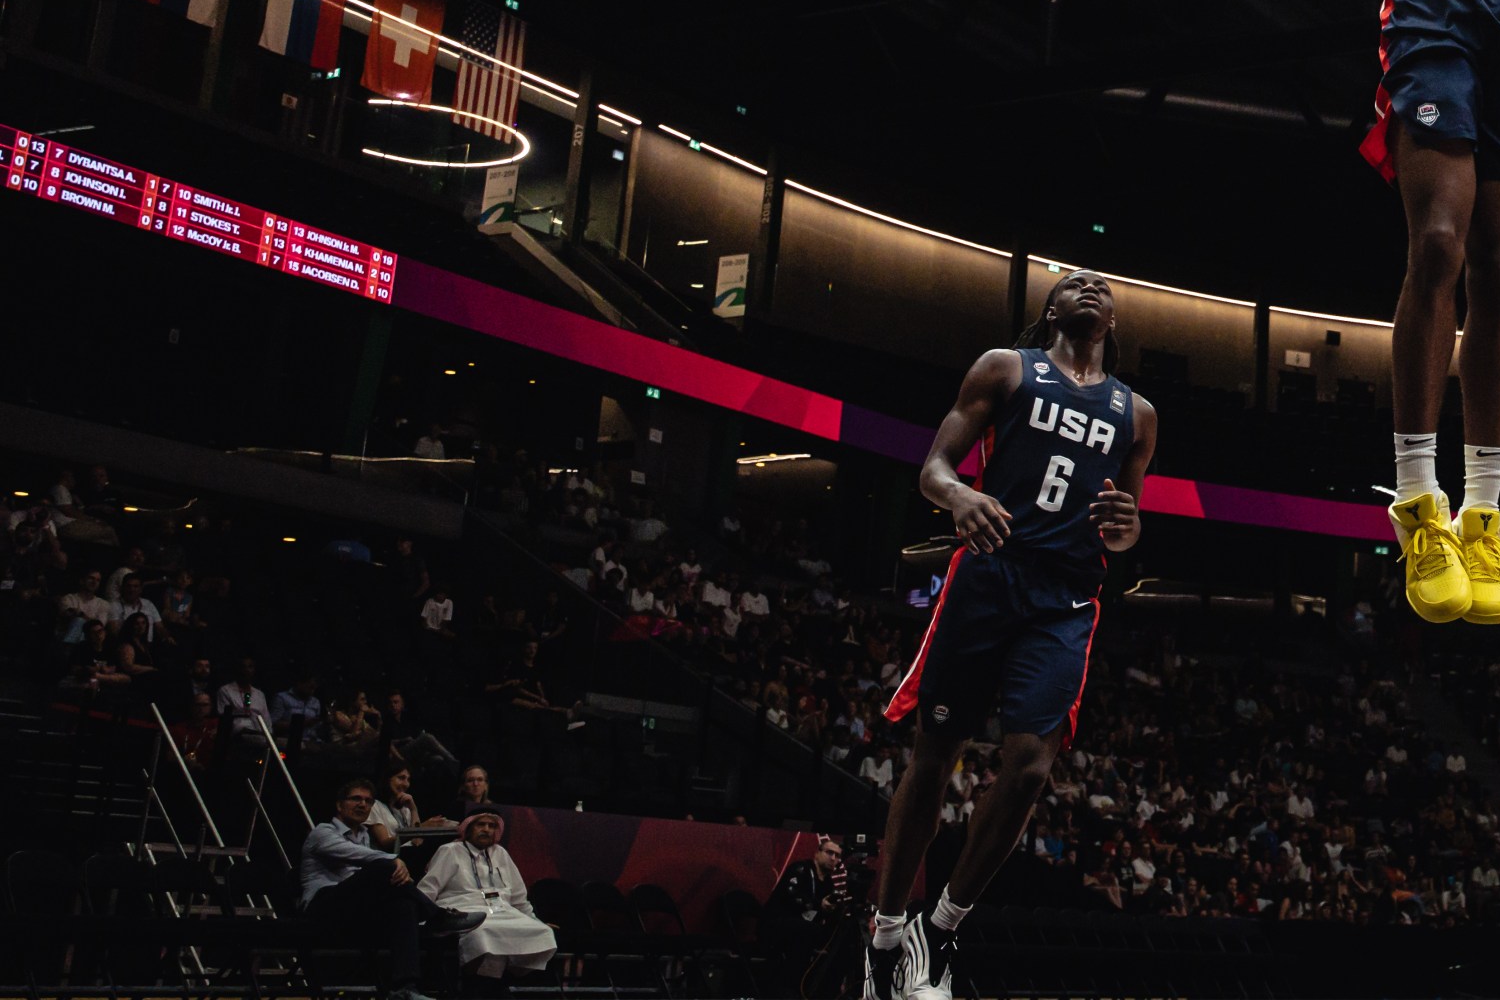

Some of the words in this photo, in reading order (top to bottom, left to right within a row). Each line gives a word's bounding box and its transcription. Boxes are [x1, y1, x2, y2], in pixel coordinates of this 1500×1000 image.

[18, 137, 28, 148] 0
[31, 141, 45, 153] 13
[14, 155, 24, 166] 0
[30, 160, 39, 170] 7
[55, 148, 64, 159] 7
[68, 152, 125, 179] DYBANTSA
[10, 174, 20, 185] 0
[23, 178, 38, 191] 10
[51, 167, 60, 178] 8
[64, 171, 118, 196] JOHNSON
[150, 180, 156, 189] 1
[162, 183, 170, 193] 7
[47, 185, 56, 196] 9
[61, 190, 102, 211] BROWN
[146, 197, 152, 207] 1
[158, 201, 167, 212] 8
[179, 189, 191, 201] 10
[193, 193, 225, 210] SMITH
[142, 215, 150, 225] 0
[155, 219, 164, 230] 3
[177, 207, 187, 218] 11
[190, 211, 231, 231] STOKES
[266, 217, 274, 227] 0
[276, 220, 288, 232] 13
[172, 225, 185, 236] 12
[294, 226, 305, 238] 13
[264, 235, 270, 244] 1
[273, 237, 285, 249] 13
[262, 252, 267, 261] 1
[273, 255, 280, 265] 7
[291, 243, 302, 254] 14
[304, 247, 354, 271] KHAMENIA
[373, 252, 380, 262] 0
[382, 255, 393, 266] 19
[288, 260, 299, 271] 15
[301, 264, 350, 288] JACOBSEN
[370, 269, 377, 278] 2
[380, 271, 390, 282] 10
[369, 285, 374, 294] 1
[377, 287, 388, 298] 10
[1029, 397, 1116, 455] USA
[1035, 455, 1076, 512] 6
